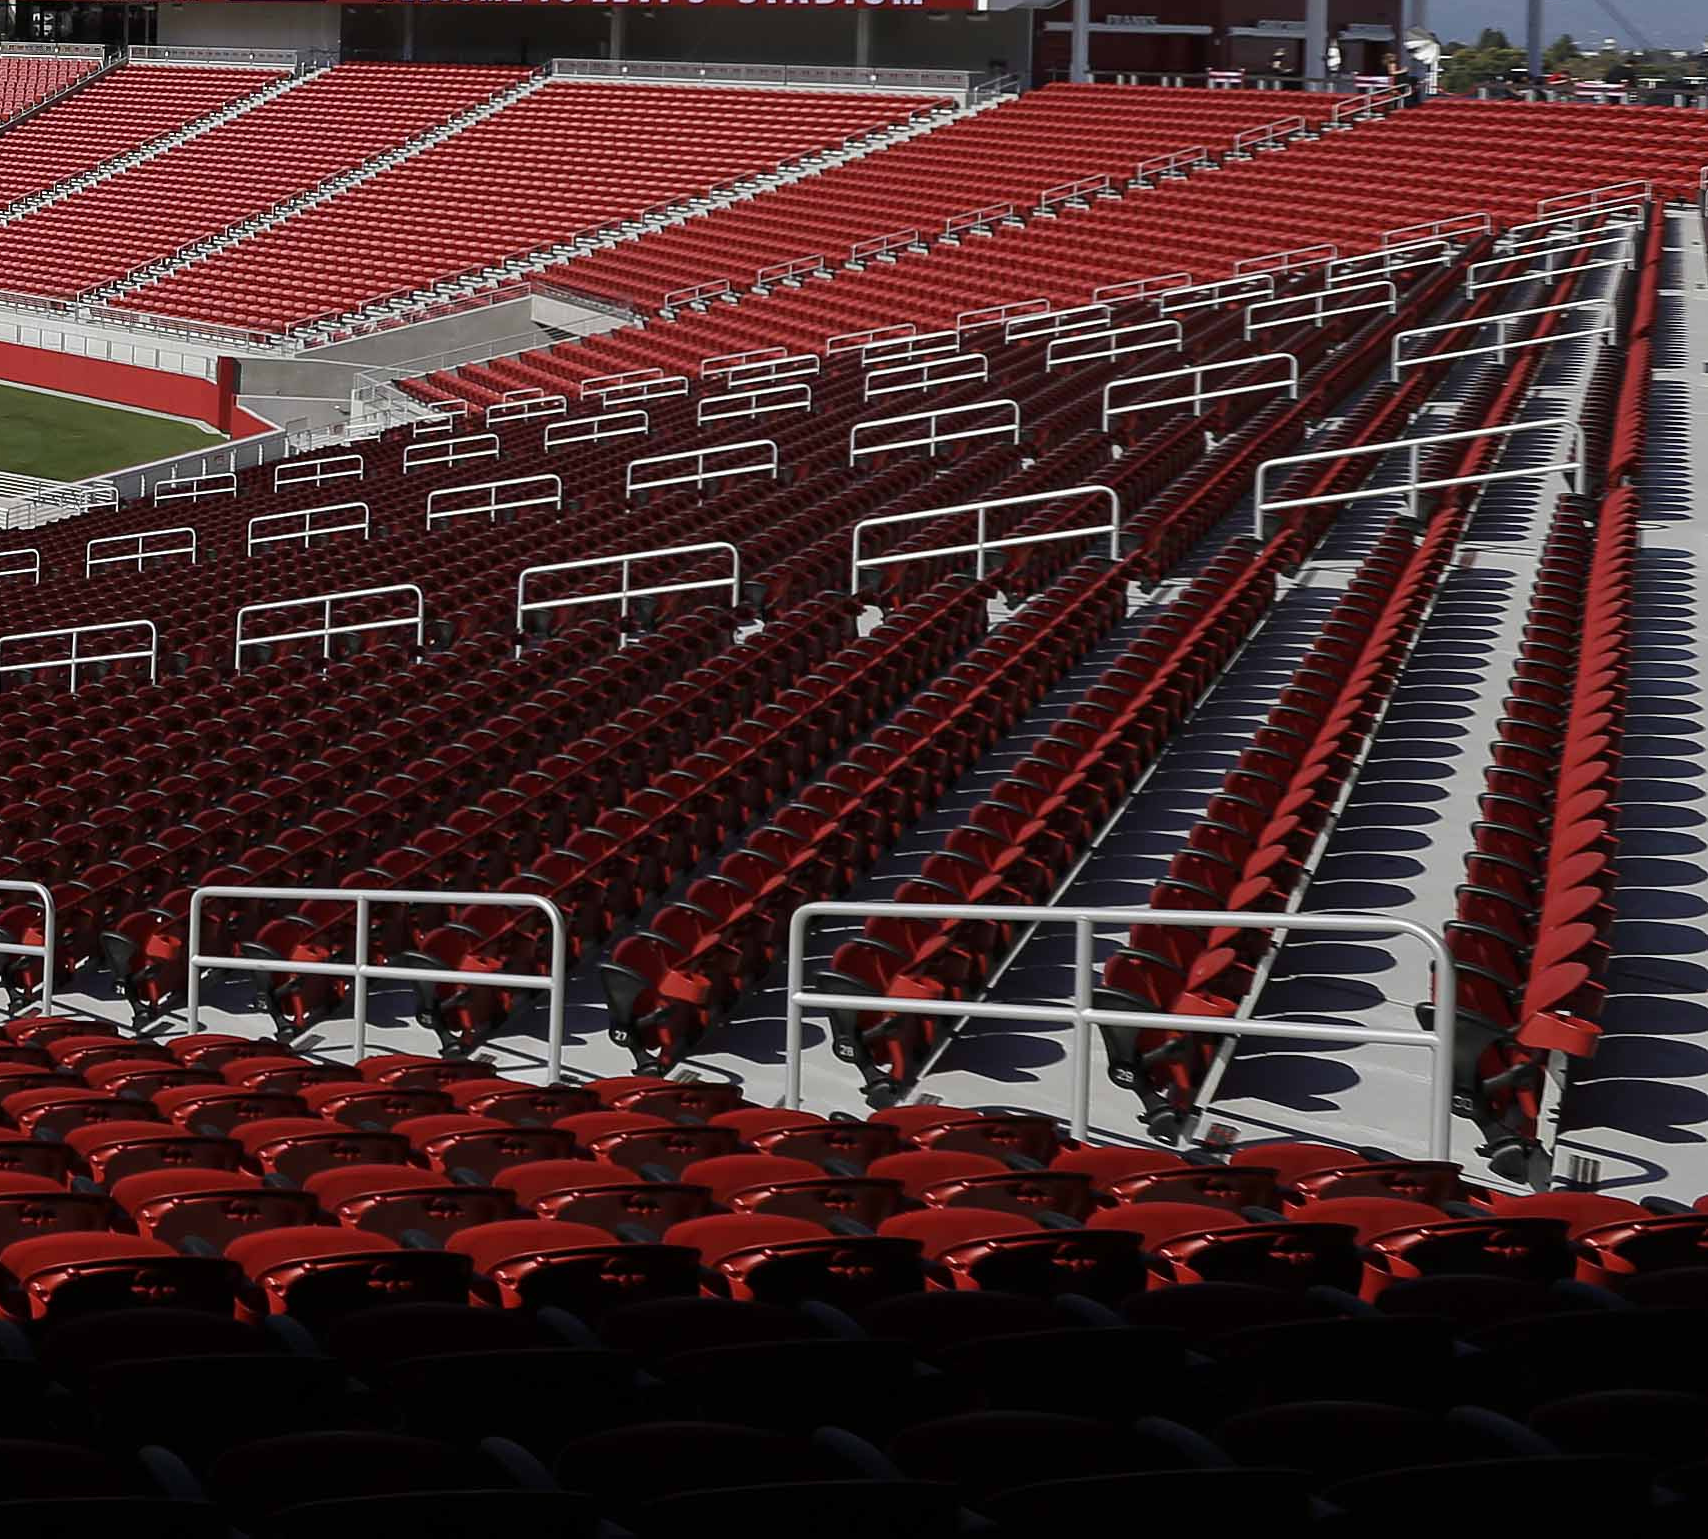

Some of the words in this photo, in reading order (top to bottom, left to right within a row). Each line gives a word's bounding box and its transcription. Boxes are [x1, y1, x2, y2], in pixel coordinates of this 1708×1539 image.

[614, 1030, 628, 1042] 27
[839, 1044, 854, 1057] 28
[1115, 1068, 1134, 1083] 29
